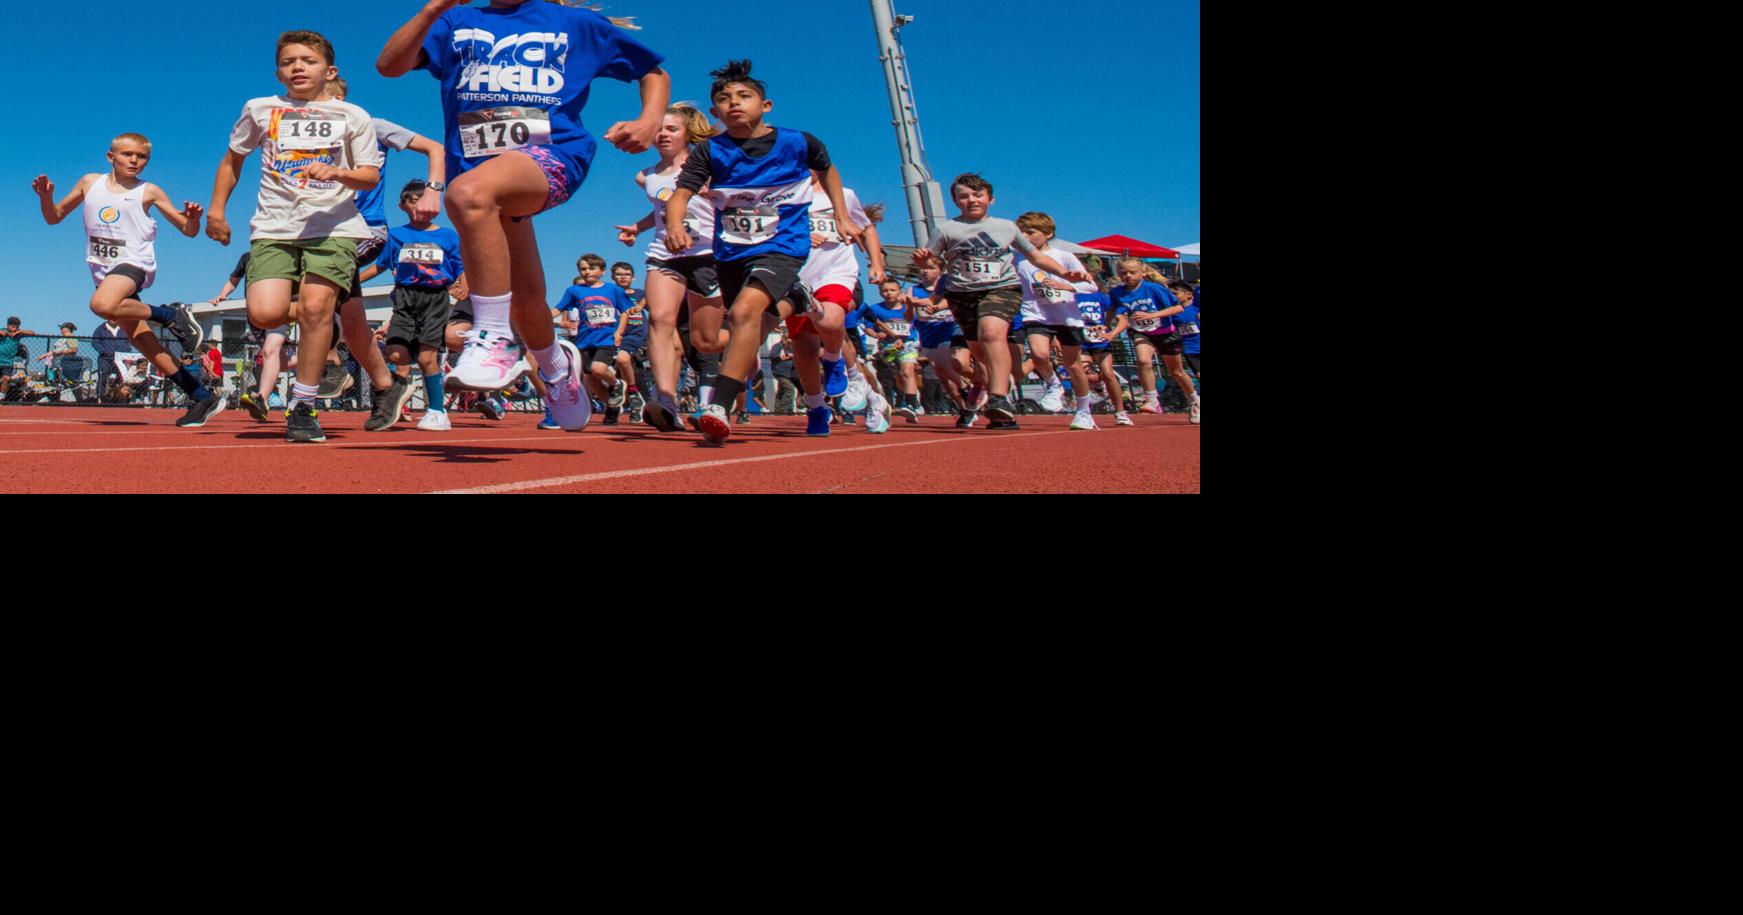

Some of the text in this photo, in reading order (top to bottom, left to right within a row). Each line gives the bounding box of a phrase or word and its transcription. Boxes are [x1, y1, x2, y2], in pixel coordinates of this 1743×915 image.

[452, 28, 568, 73] TRACK
[469, 64, 564, 94] FIELD
[457, 92, 562, 106] PATTERSON PANTHERS
[291, 121, 332, 137] 148
[475, 121, 530, 149] 170
[731, 217, 764, 233] 191
[94, 244, 119, 259] 446
[407, 249, 434, 261] 314
[964, 262, 991, 273] 151
[1038, 288, 1062, 298] 365
[591, 309, 611, 319] 324
